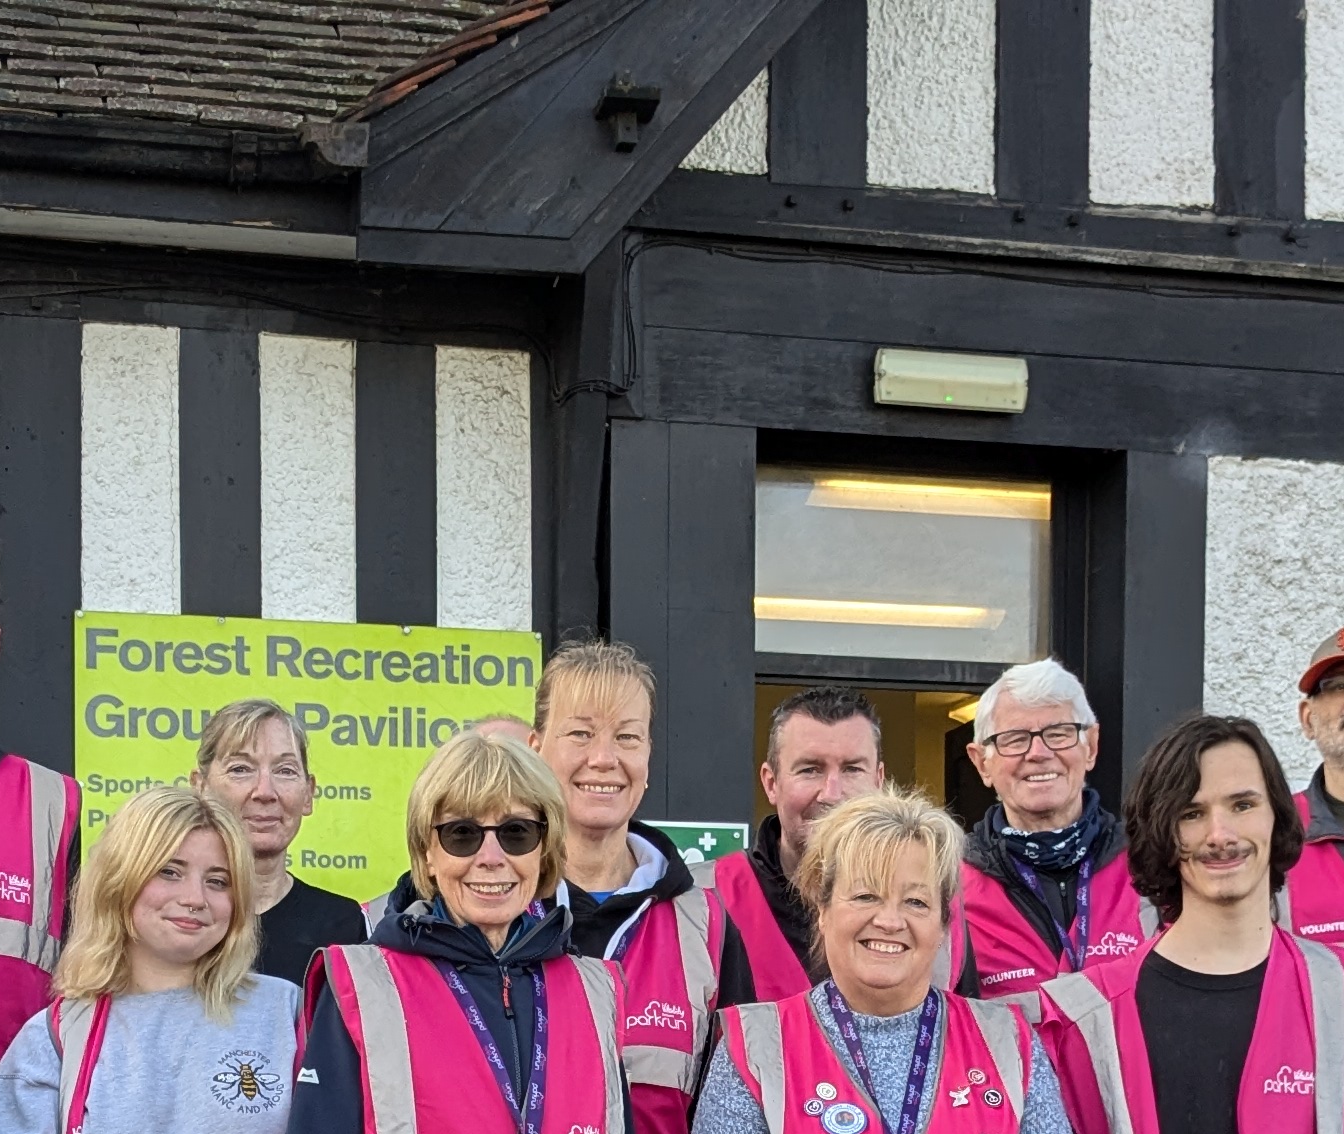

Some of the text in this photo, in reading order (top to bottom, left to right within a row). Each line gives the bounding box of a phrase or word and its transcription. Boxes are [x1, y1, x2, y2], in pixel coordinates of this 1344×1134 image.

[85, 627, 534, 688] Forest Recreation
[84, 693, 478, 748] Grou Pavilio
[301, 850, 367, 870] Room
[1085, 932, 1137, 958] parkru
[981, 967, 1035, 986] VOLUNTEER
[626, 1001, 687, 1031] parkrun
[217, 1049, 271, 1065] MANCHESTER
[210, 1083, 285, 1114] MANC AND PROUD
